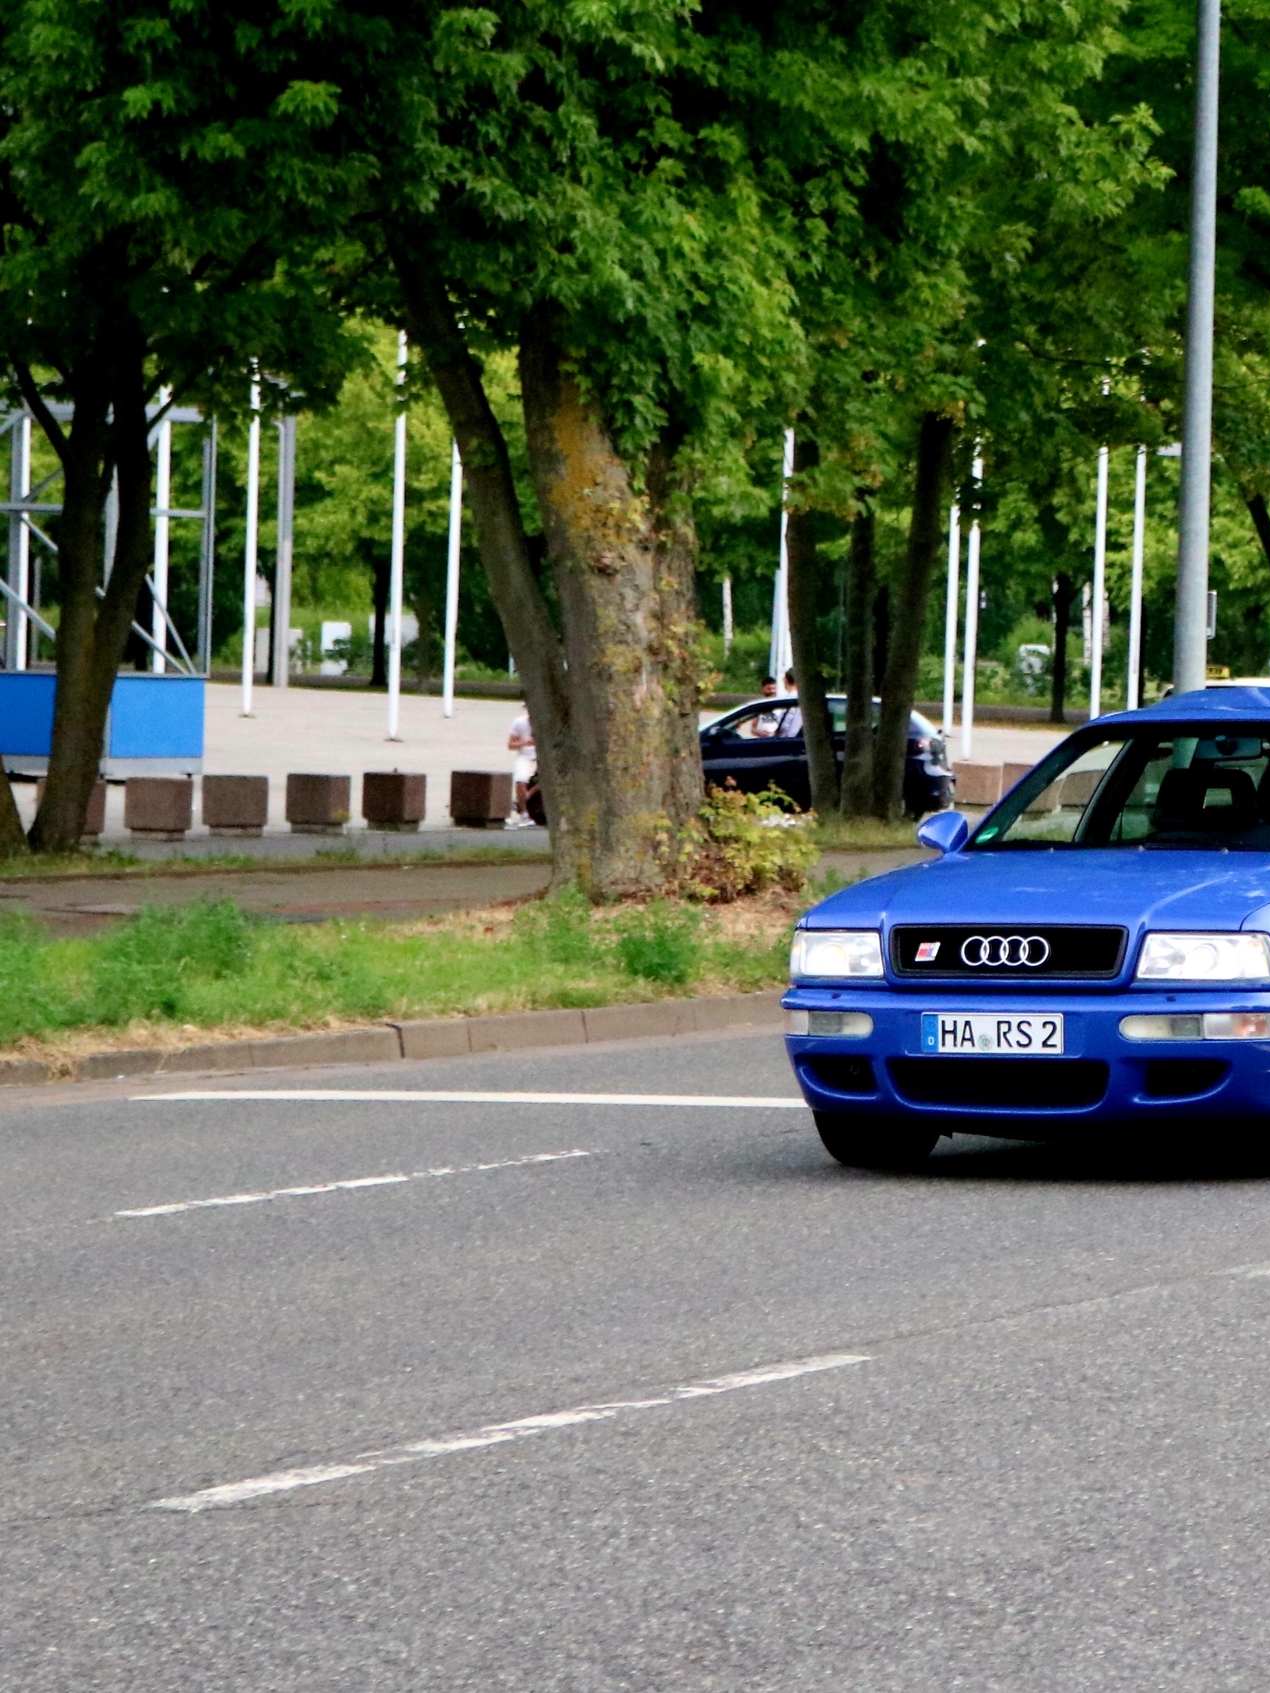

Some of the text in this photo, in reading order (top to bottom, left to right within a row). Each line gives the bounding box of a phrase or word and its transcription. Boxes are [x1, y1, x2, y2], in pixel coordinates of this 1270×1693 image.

[927, 1036, 935, 1046] D
[941, 1020, 1058, 1048] HA RS 2
